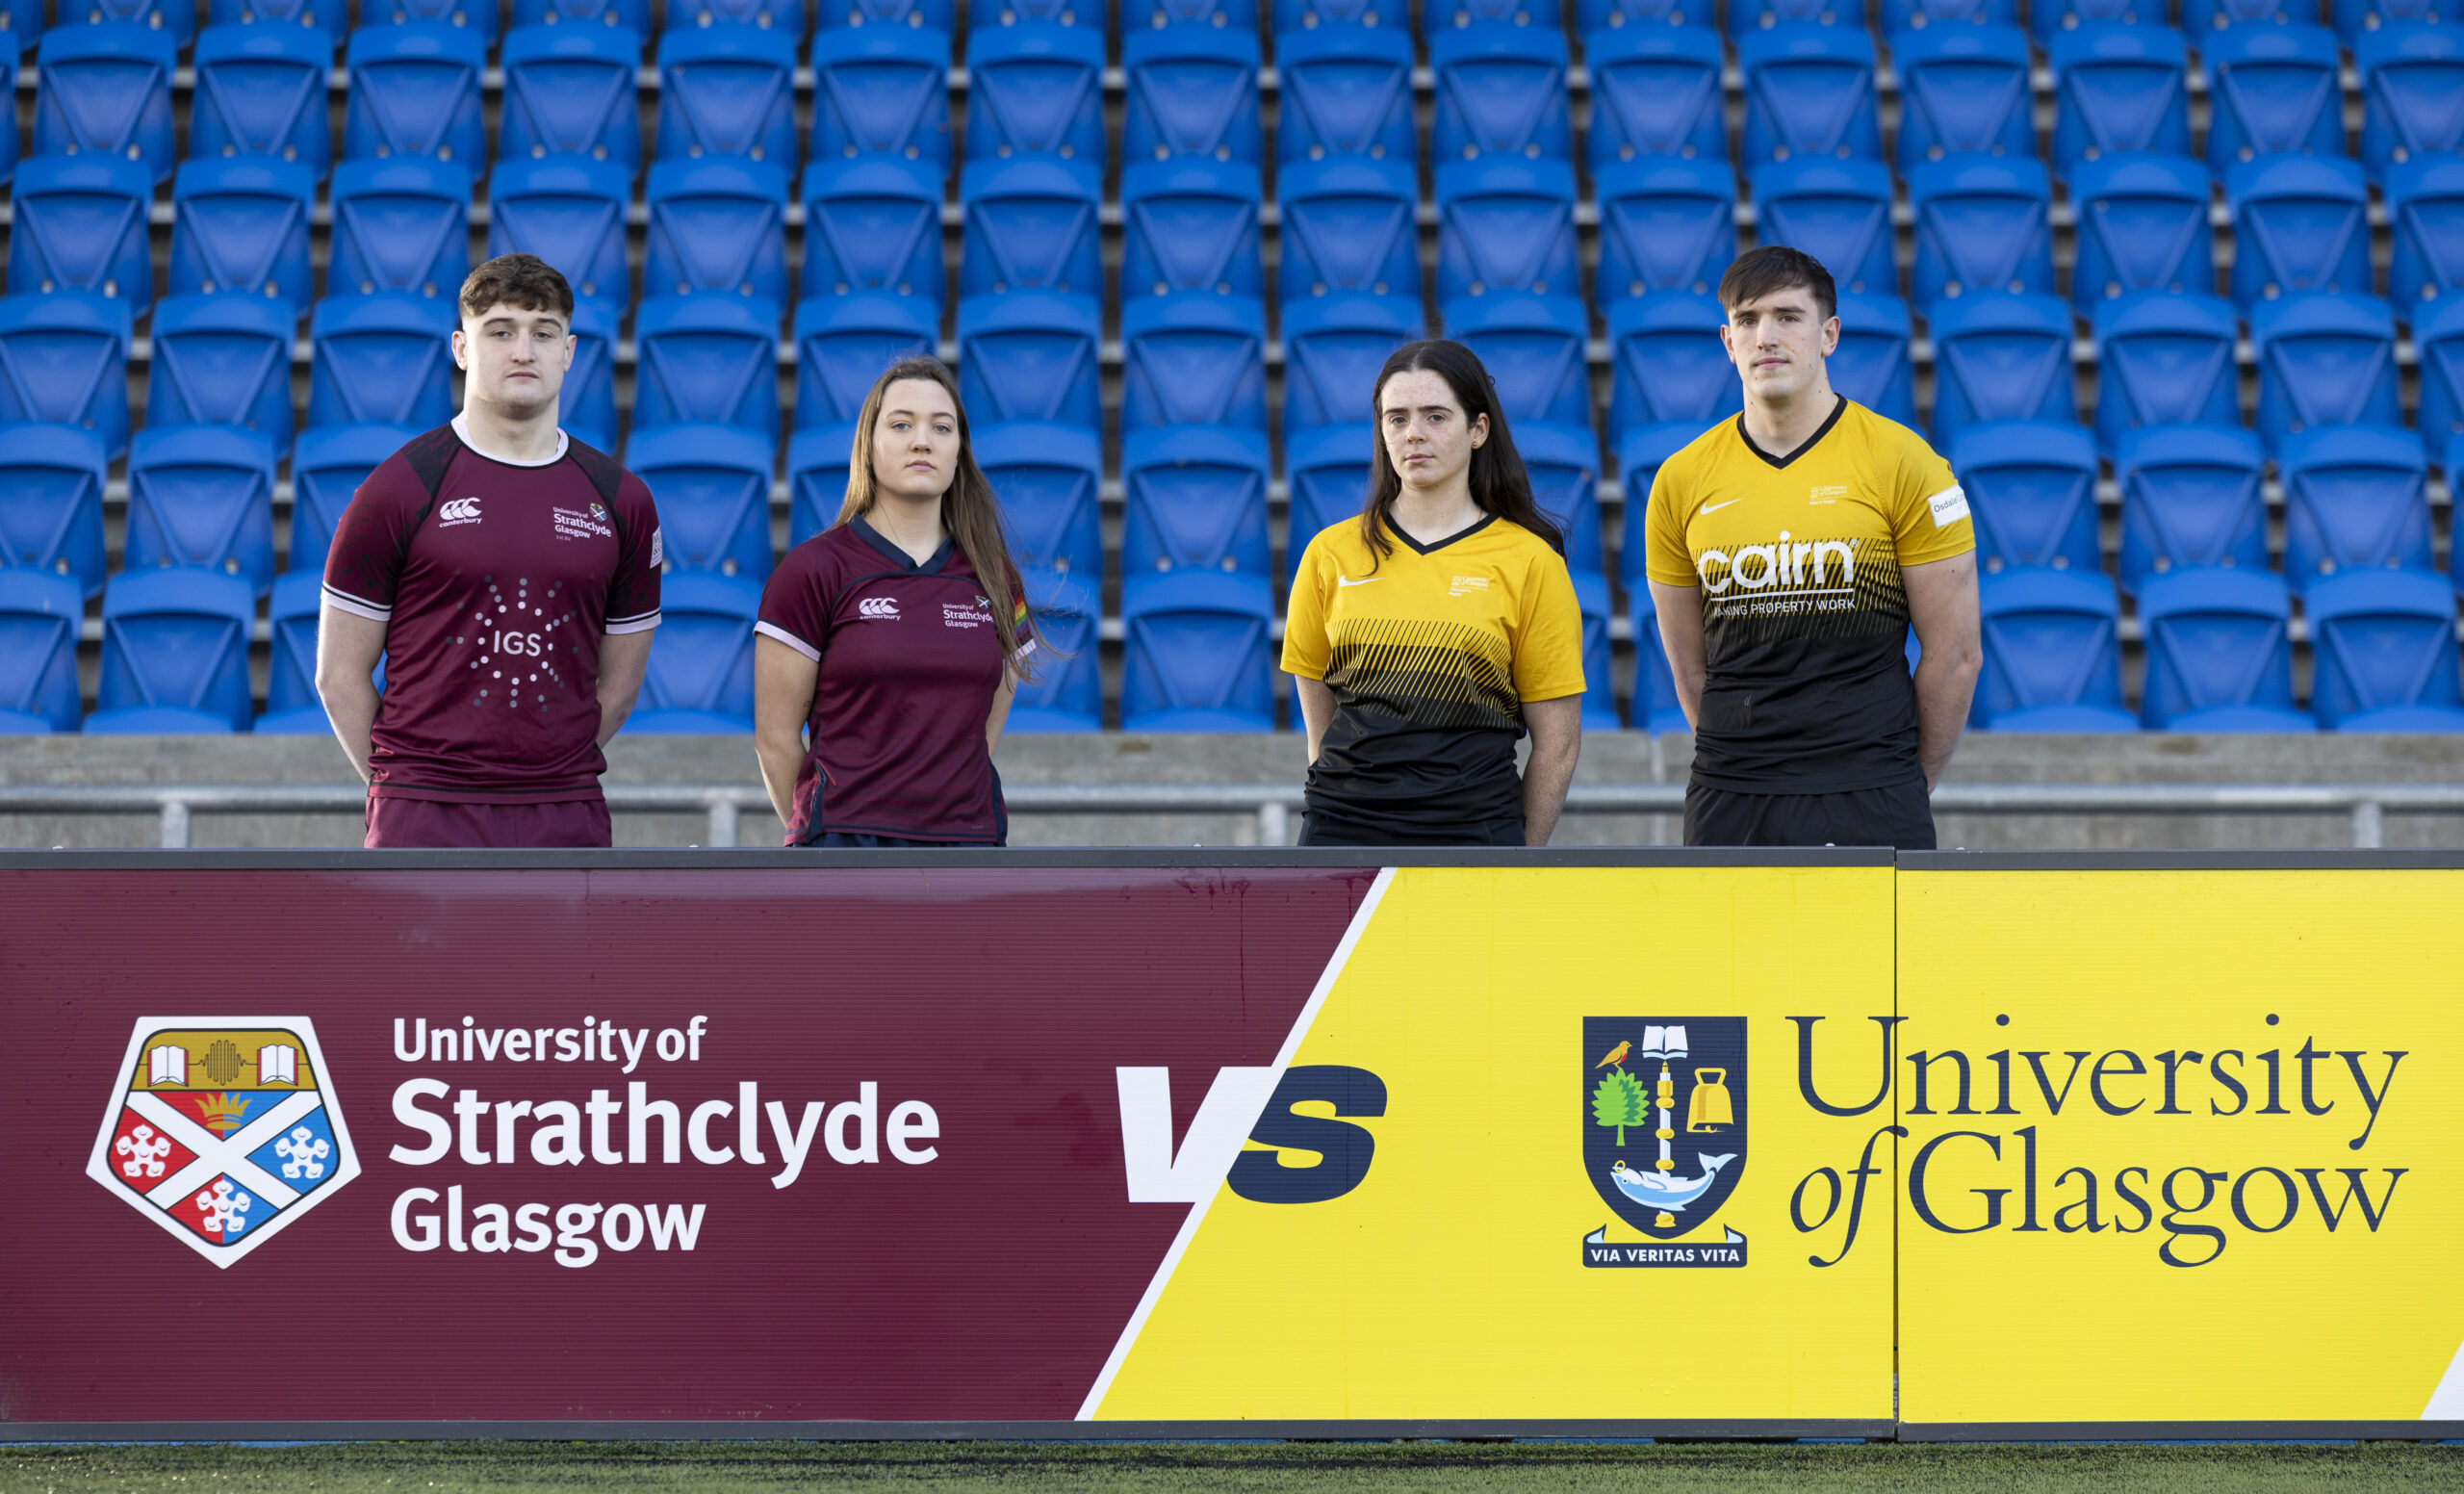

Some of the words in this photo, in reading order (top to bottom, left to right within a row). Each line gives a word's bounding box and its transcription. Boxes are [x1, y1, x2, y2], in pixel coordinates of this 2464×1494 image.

[552, 506, 582, 518] University
[439, 517, 482, 528] canterbury
[553, 513, 612, 537] Strathclyde
[554, 525, 591, 539] Glasgow
[942, 603, 968, 611] University
[1750, 600, 1813, 615] PROPERTY
[1815, 598, 1856, 611] WORK
[944, 619, 978, 629] Glasgow
[493, 631, 541, 657] IGS
[394, 1015, 650, 1074] University
[655, 1015, 708, 1062] of
[1784, 1013, 2409, 1151] University
[388, 1077, 940, 1190] Strathclyde
[1789, 1124, 1910, 1269] of
[1908, 1124, 2410, 1269] Glasgow
[390, 1184, 706, 1269] Glasgow
[1590, 1249, 1621, 1262] VIA
[1626, 1249, 1695, 1262] VERITAS
[1700, 1249, 1740, 1262] VITA
